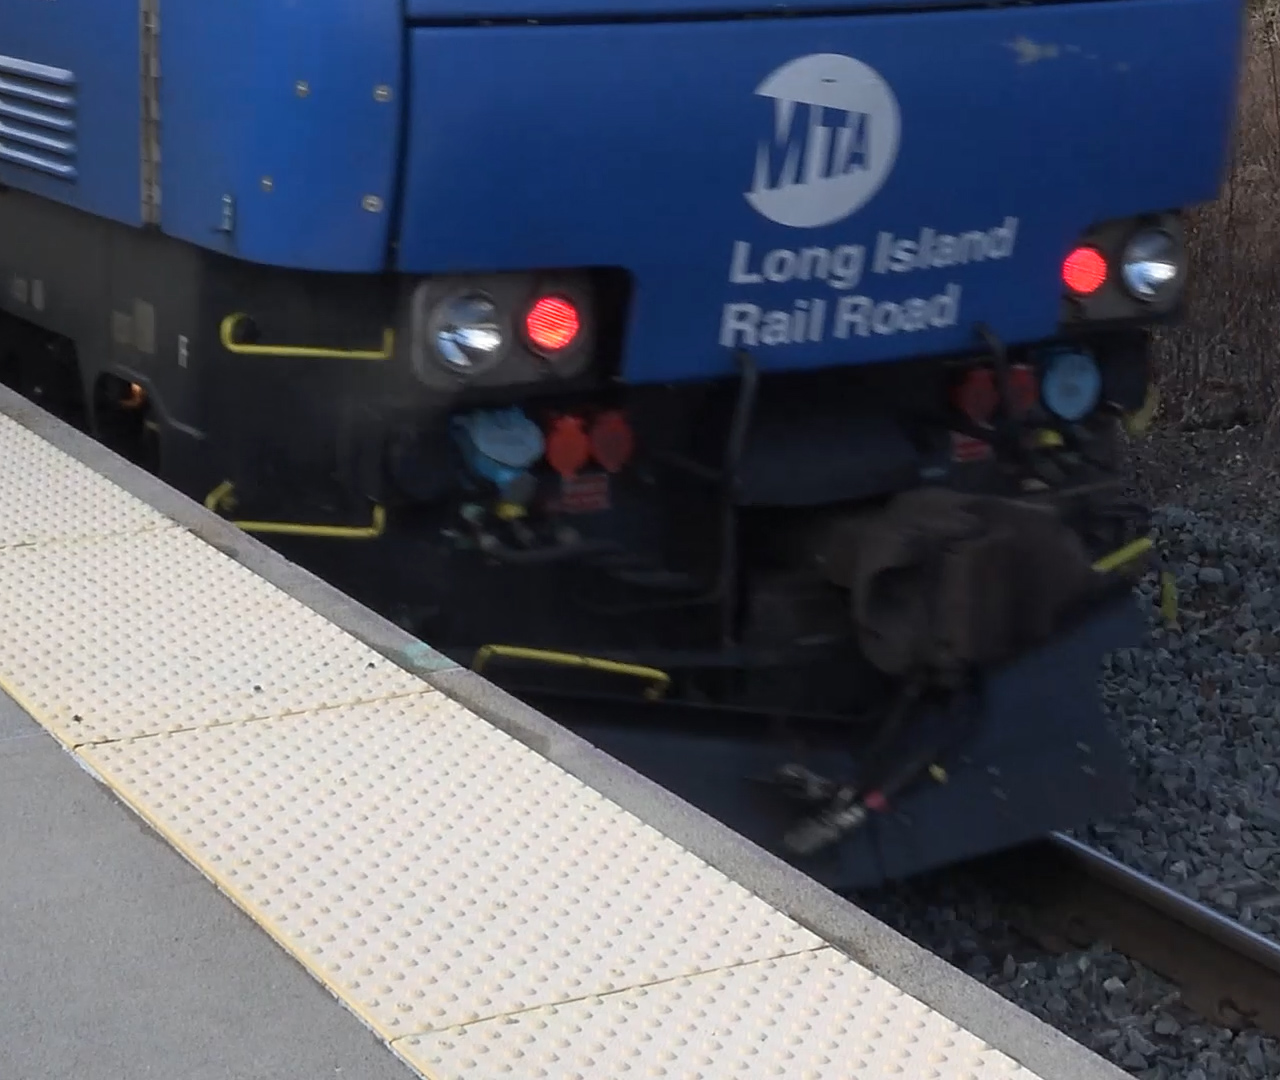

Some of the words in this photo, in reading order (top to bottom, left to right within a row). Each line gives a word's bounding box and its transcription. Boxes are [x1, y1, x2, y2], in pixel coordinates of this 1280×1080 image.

[729, 240, 867, 290] Long
[872, 216, 1019, 274] Island
[719, 297, 827, 347] Rail
[833, 282, 963, 340] Road
